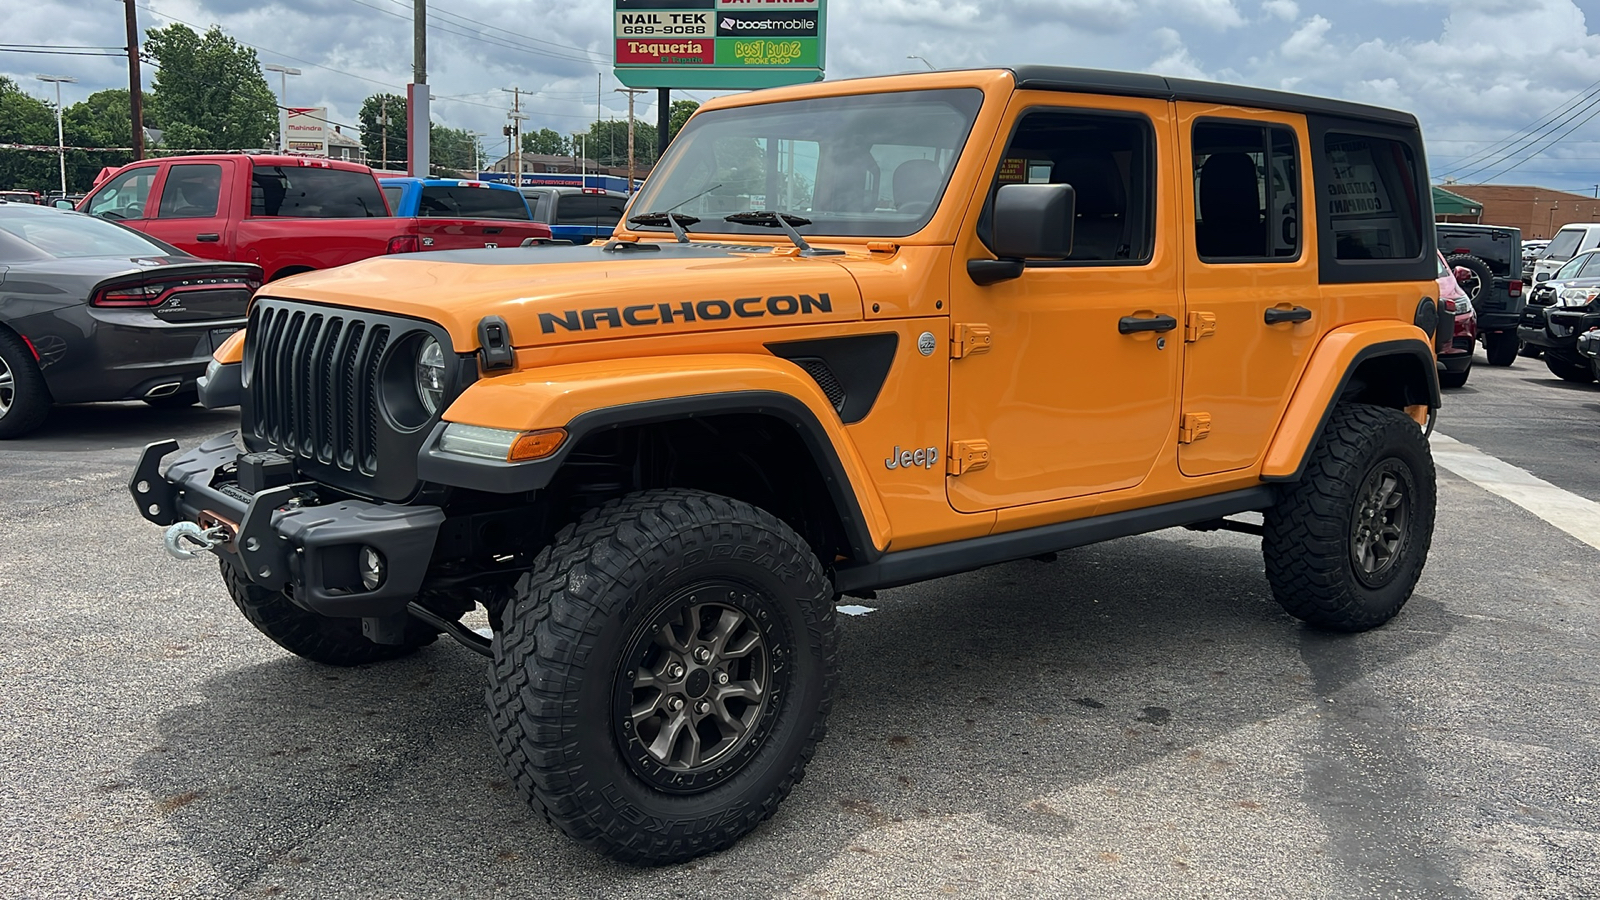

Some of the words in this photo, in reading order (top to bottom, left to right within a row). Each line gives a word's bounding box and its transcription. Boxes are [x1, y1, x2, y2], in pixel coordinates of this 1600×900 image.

[621, 14, 662, 24] NAIL
[669, 13, 706, 24] TEK
[623, 26, 706, 34] 689-9088
[537, 292, 833, 335] NACHOCON
[884, 445, 939, 471] Jeep
